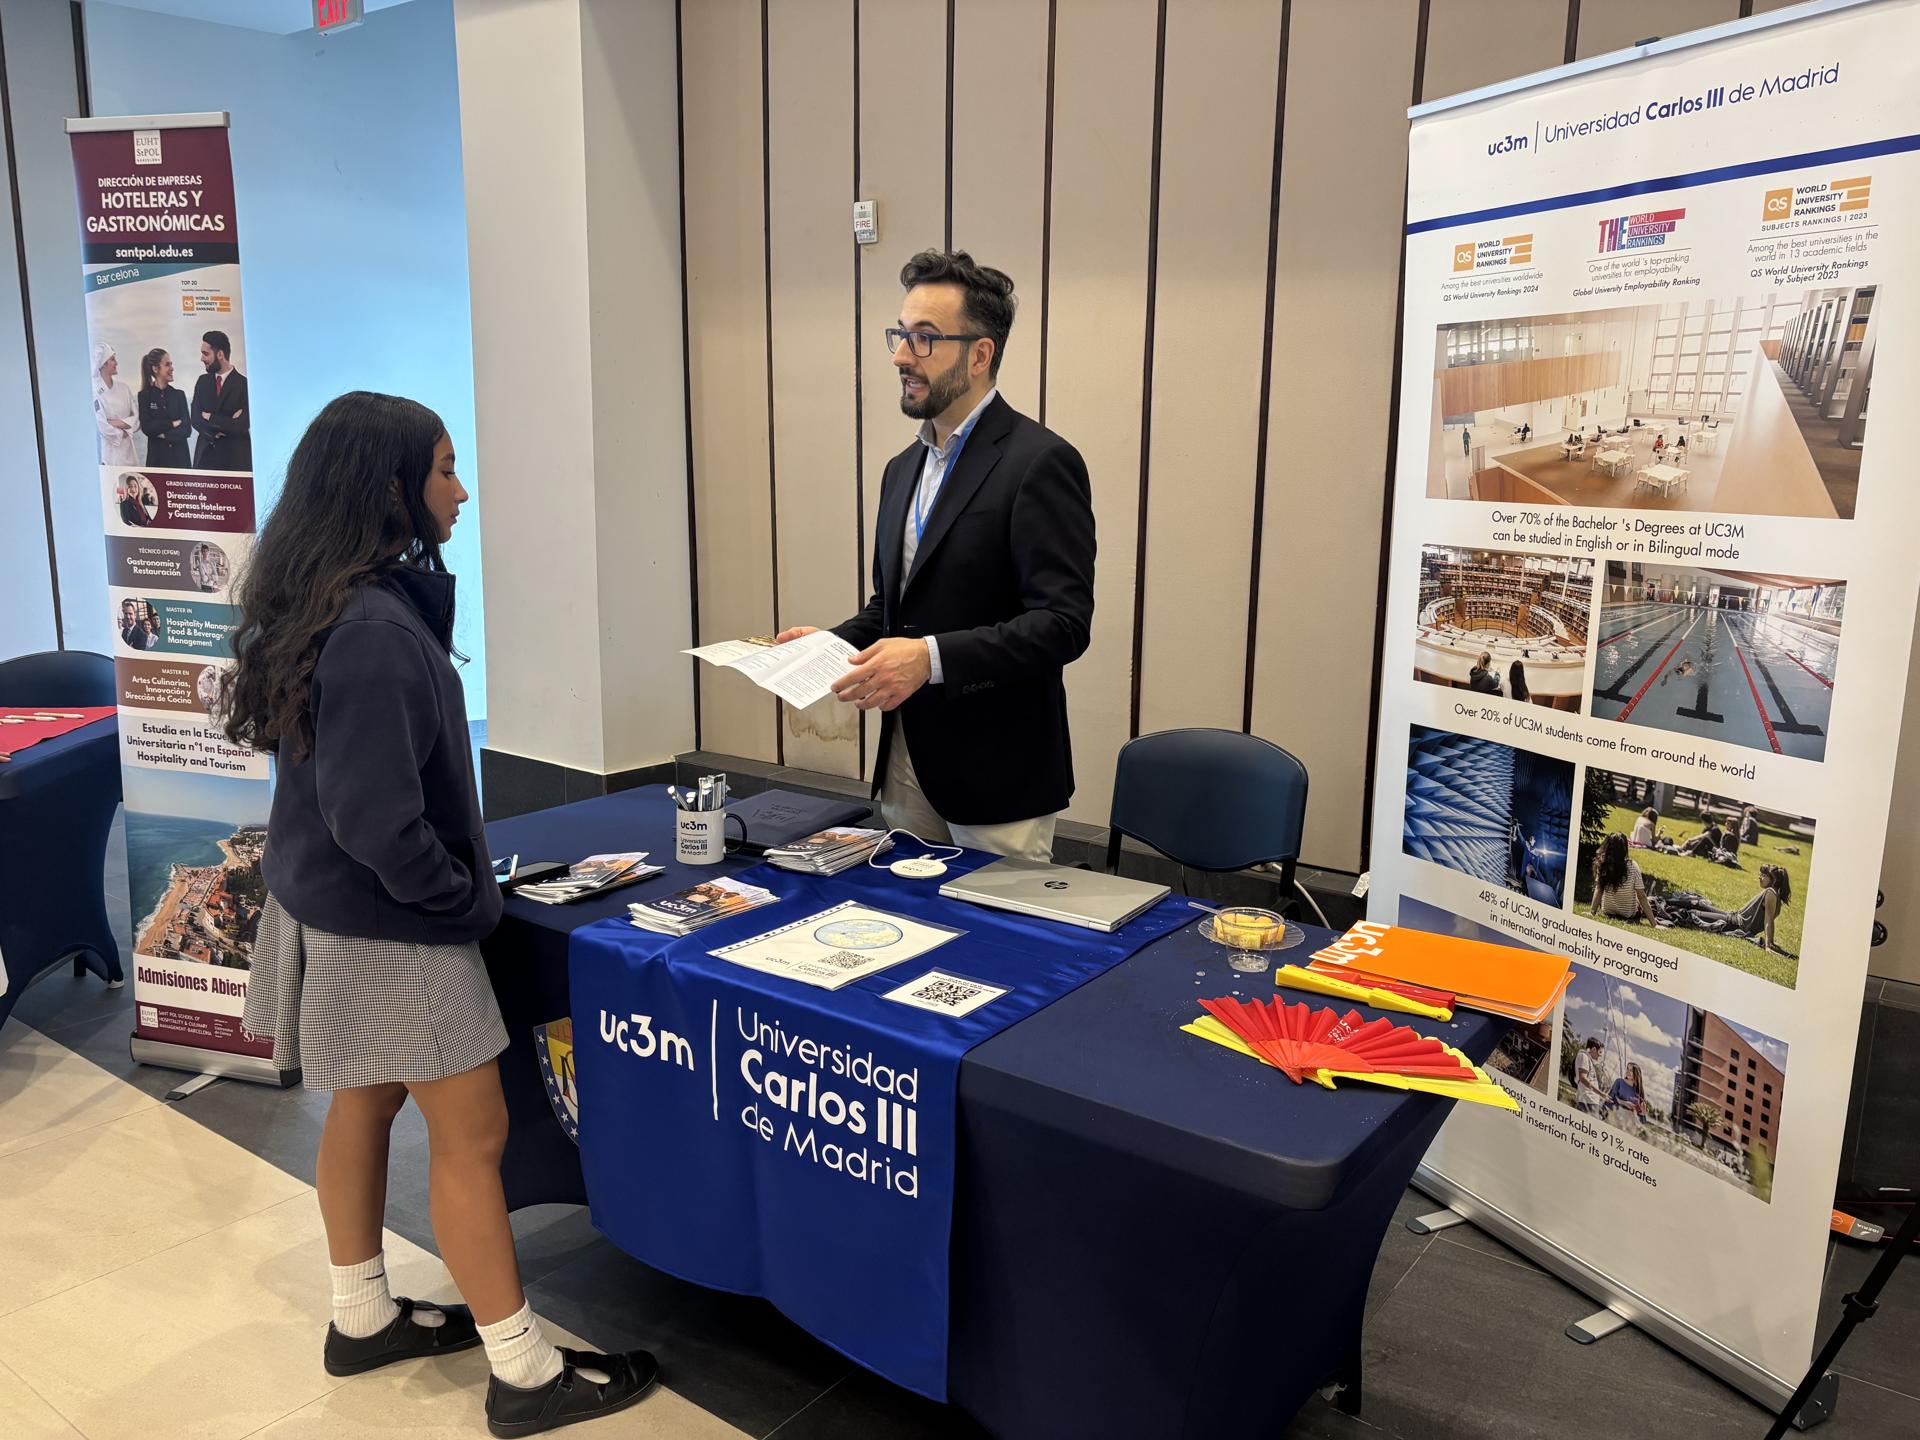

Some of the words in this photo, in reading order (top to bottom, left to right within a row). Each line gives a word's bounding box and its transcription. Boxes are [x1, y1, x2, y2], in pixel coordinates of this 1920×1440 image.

[1487, 135, 1529, 157] uc3m
[1545, 106, 1640, 144] Universidad
[1645, 95, 1703, 121] Carlos
[1705, 87, 1724, 110] III
[1729, 84, 1755, 104] de
[1759, 63, 1840, 97] Madrid
[136, 138, 159, 146] EUHT
[98, 174, 144, 187] DIRECCIÓN
[145, 177, 156, 186] DE
[158, 175, 202, 186] EMPRESAS
[1796, 184, 1827, 195] WORLD
[101, 190, 188, 209] HOTELERAS
[190, 190, 203, 207] Y
[1767, 197, 1788, 213] QS
[1795, 192, 1844, 206] UNIVERSITY
[1793, 204, 1836, 217] RANKINGS
[86, 210, 225, 232] GASTRONÓMICAS
[856, 220, 871, 229] FIRE
[1629, 213, 1655, 225] WORLD
[1761, 221, 1800, 232] SUBJECTS
[1802, 215, 1842, 226] RANKINGS
[1849, 212, 1868, 221] 2023
[1599, 216, 1629, 253] THE
[1628, 223, 1670, 237] UNIVERSITY
[1477, 240, 1501, 250] WORLD
[1627, 235, 1664, 248] RANKINGS
[1747, 243, 1774, 254] Among
[1776, 240, 1789, 249] the
[1790, 238, 1807, 249] best
[1809, 234, 1853, 247] universities
[1855, 232, 1863, 241] in
[1865, 230, 1879, 240] the
[116, 244, 194, 260] santpol.edu.es
[1456, 251, 1473, 265] QS
[1476, 247, 1513, 259] UNIVERSITY
[1754, 251, 1776, 263] world
[1778, 251, 1786, 259] in
[1790, 249, 1800, 259] 13
[1802, 246, 1843, 257] academic
[1845, 241, 1868, 253] fields
[1476, 257, 1507, 269] RANKINGS
[1588, 263, 1604, 273] One
[1604, 261, 1612, 271] of
[1611, 260, 1621, 271] the
[1621, 258, 1639, 270] world
[1750, 269, 1763, 279] QS
[1764, 265, 1789, 276] World
[1790, 263, 1830, 275] University
[1831, 259, 1869, 270] Rankings
[96, 268, 140, 285] Barcelona
[1774, 276, 1785, 286] by
[1786, 273, 1815, 284] Subject
[1816, 270, 1839, 280] 2023
[1572, 287, 1594, 297] Global
[1623, 279, 1671, 292] Employability
[1672, 276, 1701, 288] Ranking
[167, 491, 198, 501] Dirección
[198, 493, 208, 501] de
[167, 500, 201, 511] Empresas
[201, 502, 237, 512] Hoteleras
[168, 512, 173, 520] y
[174, 510, 225, 521] Gastronómicas
[1492, 510, 1517, 524] Over
[1519, 512, 1541, 525] 70%
[1543, 514, 1554, 526] of
[1553, 514, 1570, 527] the
[1572, 517, 1618, 531] Bachelor
[1635, 519, 1685, 537] Degrees
[1689, 523, 1702, 536] at
[1704, 522, 1745, 538] UC3M
[1492, 532, 1510, 541] can
[1513, 530, 1526, 543] be
[1528, 531, 1561, 546] studied
[1564, 534, 1573, 546] in
[1575, 535, 1612, 552] English
[1616, 541, 1630, 551] or
[1633, 538, 1644, 552] in
[1648, 539, 1702, 559] Bilingual
[1706, 544, 1740, 560] mode
[127, 557, 175, 568] Gastronomía
[175, 561, 181, 570] y
[133, 565, 182, 577] Restauración
[166, 618, 204, 629] Hospitality
[167, 627, 186, 636] Food
[187, 628, 193, 636] &
[167, 635, 213, 647] Management
[131, 675, 151, 684] Artes
[125, 691, 156, 701] Dirección
[156, 694, 166, 702] de
[167, 695, 192, 705] Cocina
[145, 685, 185, 695] Innovación
[186, 689, 192, 697] y
[142, 723, 177, 736] Estudia
[179, 728, 191, 736] en
[193, 727, 202, 738] la
[204, 729, 228, 741] Escue
[126, 735, 187, 750] Universitaria
[204, 746, 216, 754] en
[217, 745, 255, 758] España!
[1454, 703, 1479, 718] Over
[1480, 707, 1501, 724] 20%
[1503, 711, 1515, 726] of
[1514, 715, 1543, 734] UC3M
[1545, 723, 1583, 744] students
[1586, 734, 1617, 750] come
[1619, 737, 1647, 756] from
[1650, 747, 1696, 766] around
[1699, 754, 1717, 771] the
[1720, 763, 1756, 780] world
[137, 750, 188, 767] Hospitality
[190, 756, 208, 767] and
[209, 757, 246, 772] Tourism
[680, 820, 708, 831] uc3m
[1478, 890, 1498, 905] 48%
[1500, 895, 1510, 909] of
[1511, 900, 1541, 922] UC3M
[1542, 916, 1593, 942] graduates
[1596, 931, 1623, 952] have
[1626, 946, 1679, 971] engaged
[1490, 909, 1499, 923] in
[1500, 913, 1557, 947] international
[1558, 936, 1601, 965] mobility
[1603, 955, 1659, 984] programs
[137, 966, 208, 992] Admisiones
[211, 977, 248, 998] Abiert
[599, 1009, 695, 1072] uc3m
[737, 1006, 918, 1104] Universidad
[740, 1049, 867, 1135] Carlos
[877, 1097, 917, 1156] III
[1529, 1100, 1536, 1109] a
[1538, 1105, 1598, 1139] remarkable
[1601, 1131, 1625, 1153] 91%
[1627, 1147, 1650, 1165] rate
[740, 1102, 774, 1142] de
[783, 1121, 918, 1199] Madrid
[1526, 1111, 1567, 1142] insertion
[1570, 1132, 1586, 1150] for
[1588, 1142, 1601, 1158] its
[1602, 1153, 1658, 1188] graduates
